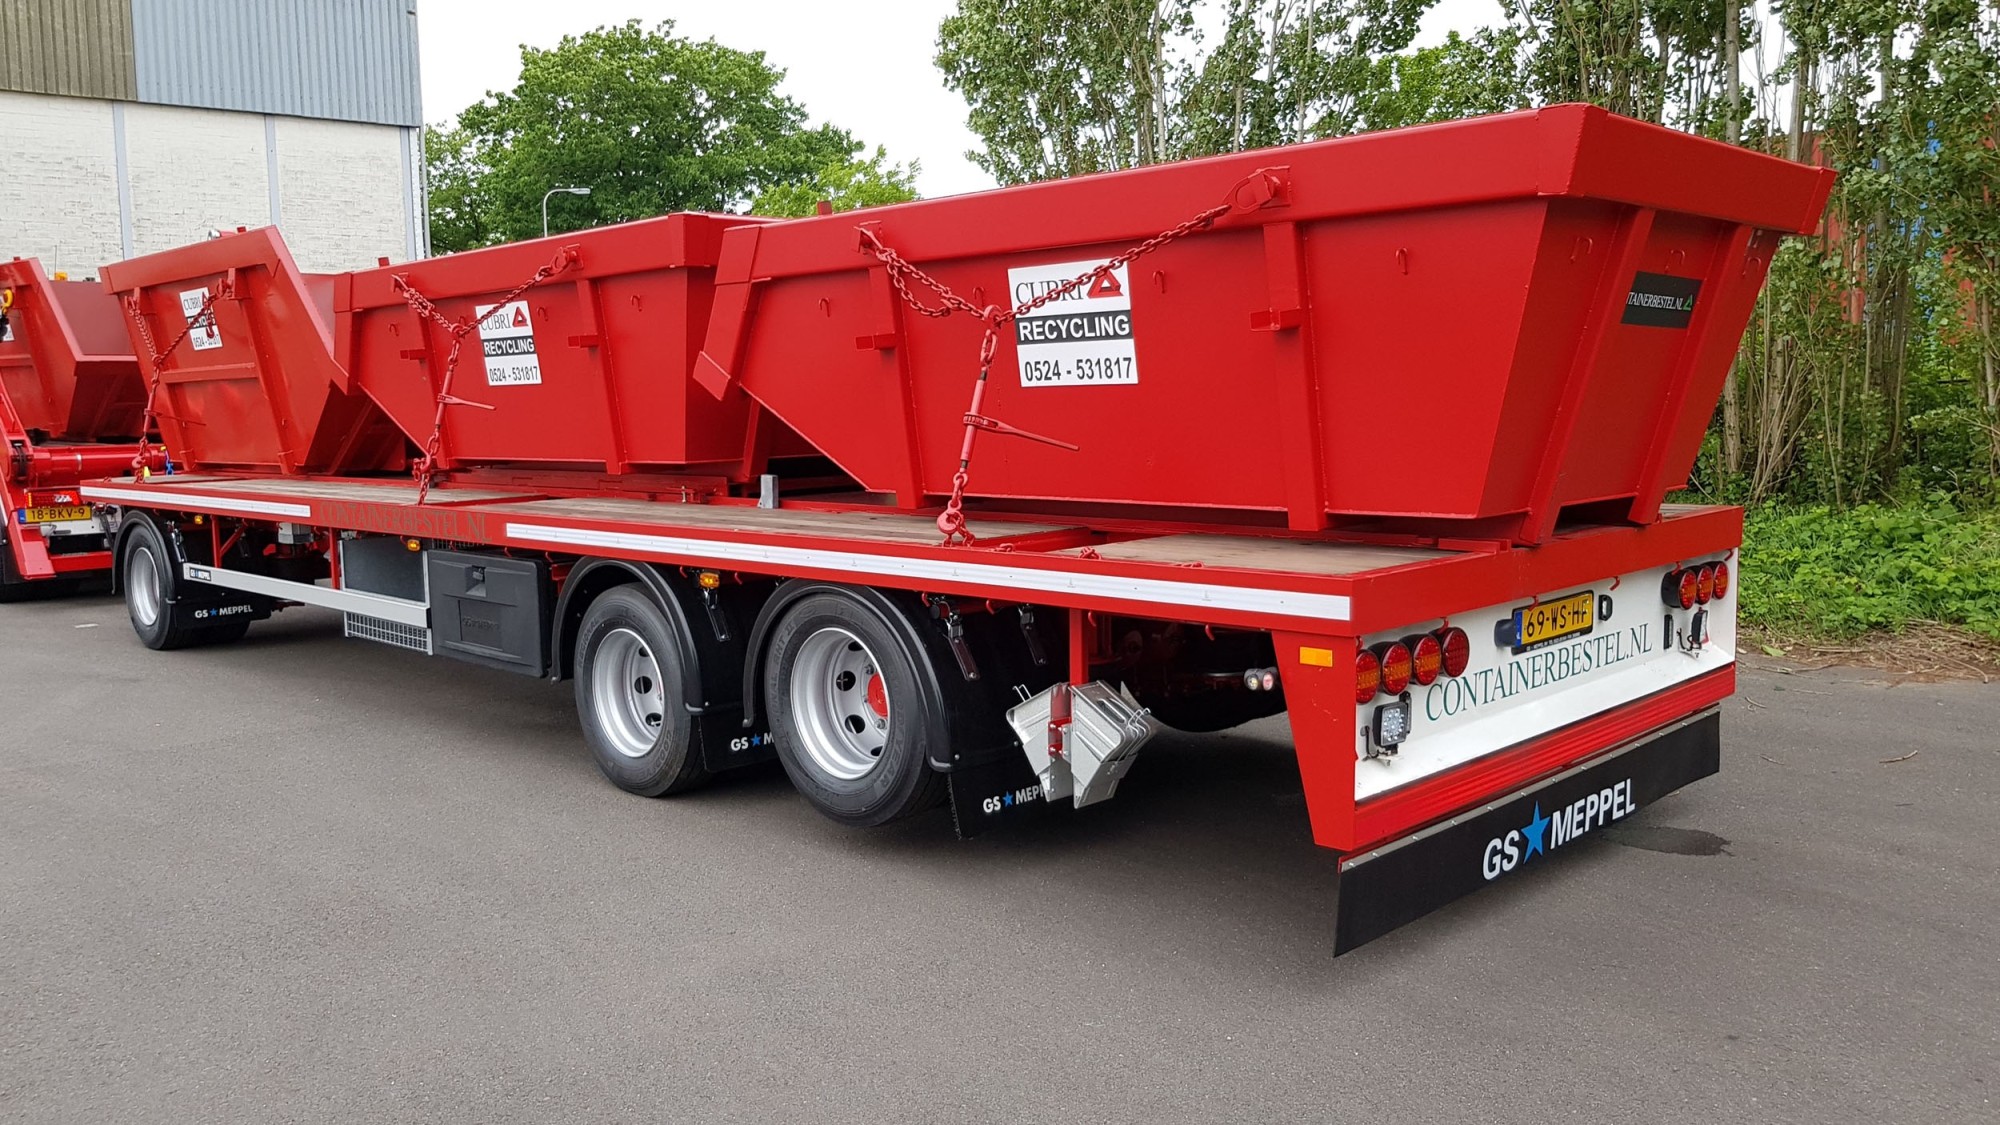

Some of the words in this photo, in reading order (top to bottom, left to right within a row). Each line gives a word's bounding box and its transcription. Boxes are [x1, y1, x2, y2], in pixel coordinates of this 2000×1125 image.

[1018, 314, 1130, 341] RECYCLING
[483, 338, 535, 355] RECYCLING
[489, 367, 507, 382] 0524
[512, 365, 538, 381] 531817
[1024, 359, 1062, 381] 0524
[1076, 357, 1132, 380] 531817
[31, 507, 85, 520] 18-BKV-9
[194, 609, 209, 618] GS
[219, 604, 253, 616] MEPPEL
[1526, 599, 1589, 638] 69-WS-HF
[1426, 622, 1653, 721] CONTAINERBESTEL.NL
[730, 736, 749, 751] GS
[982, 795, 1001, 813] GS
[1482, 829, 1520, 881] GS
[1550, 778, 1636, 850] MEPPEL
